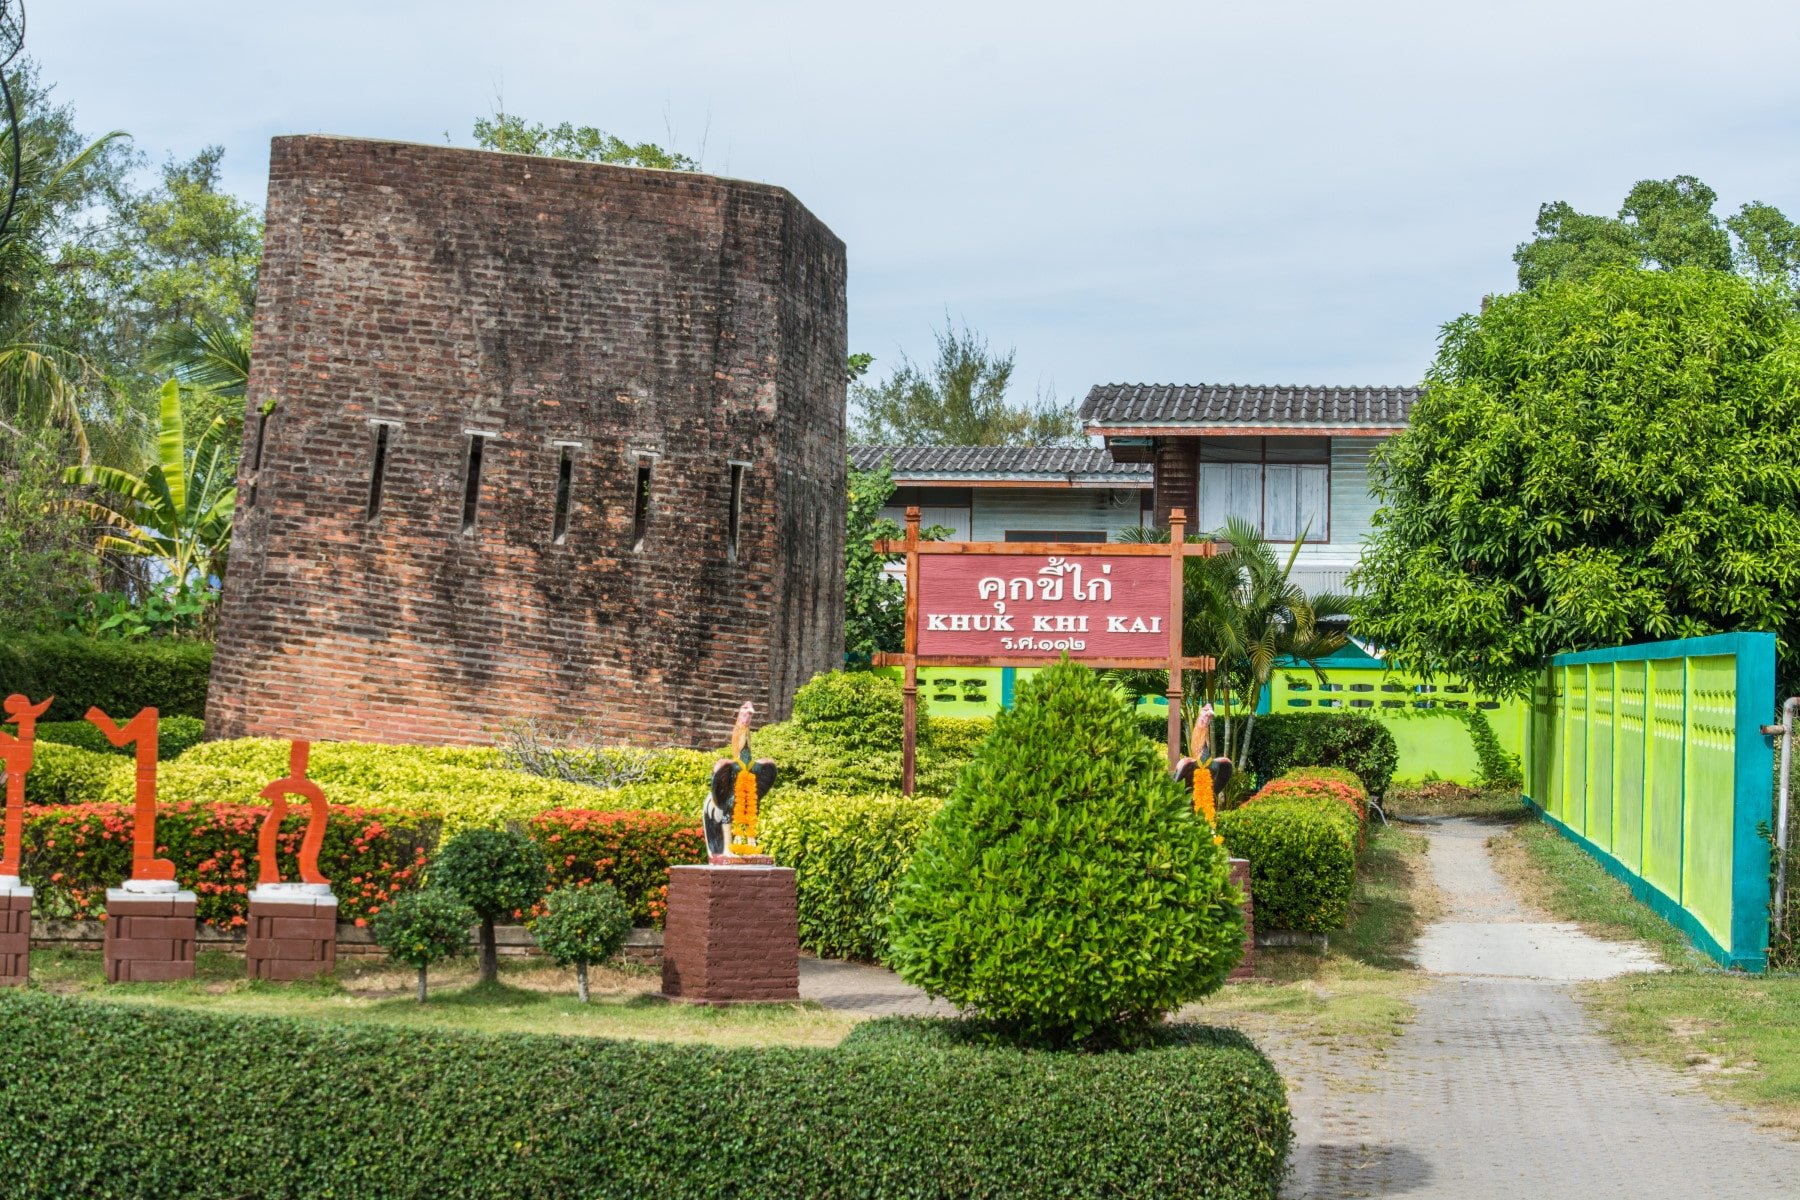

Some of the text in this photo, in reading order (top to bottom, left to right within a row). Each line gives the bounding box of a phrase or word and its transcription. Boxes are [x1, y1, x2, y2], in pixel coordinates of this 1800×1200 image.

[978, 556, 1113, 614] คุกขี้ไก่
[926, 613, 1162, 633] KHUK KHI KAI
[1000, 636, 1086, 651] ร.ศ.๑๑๒
